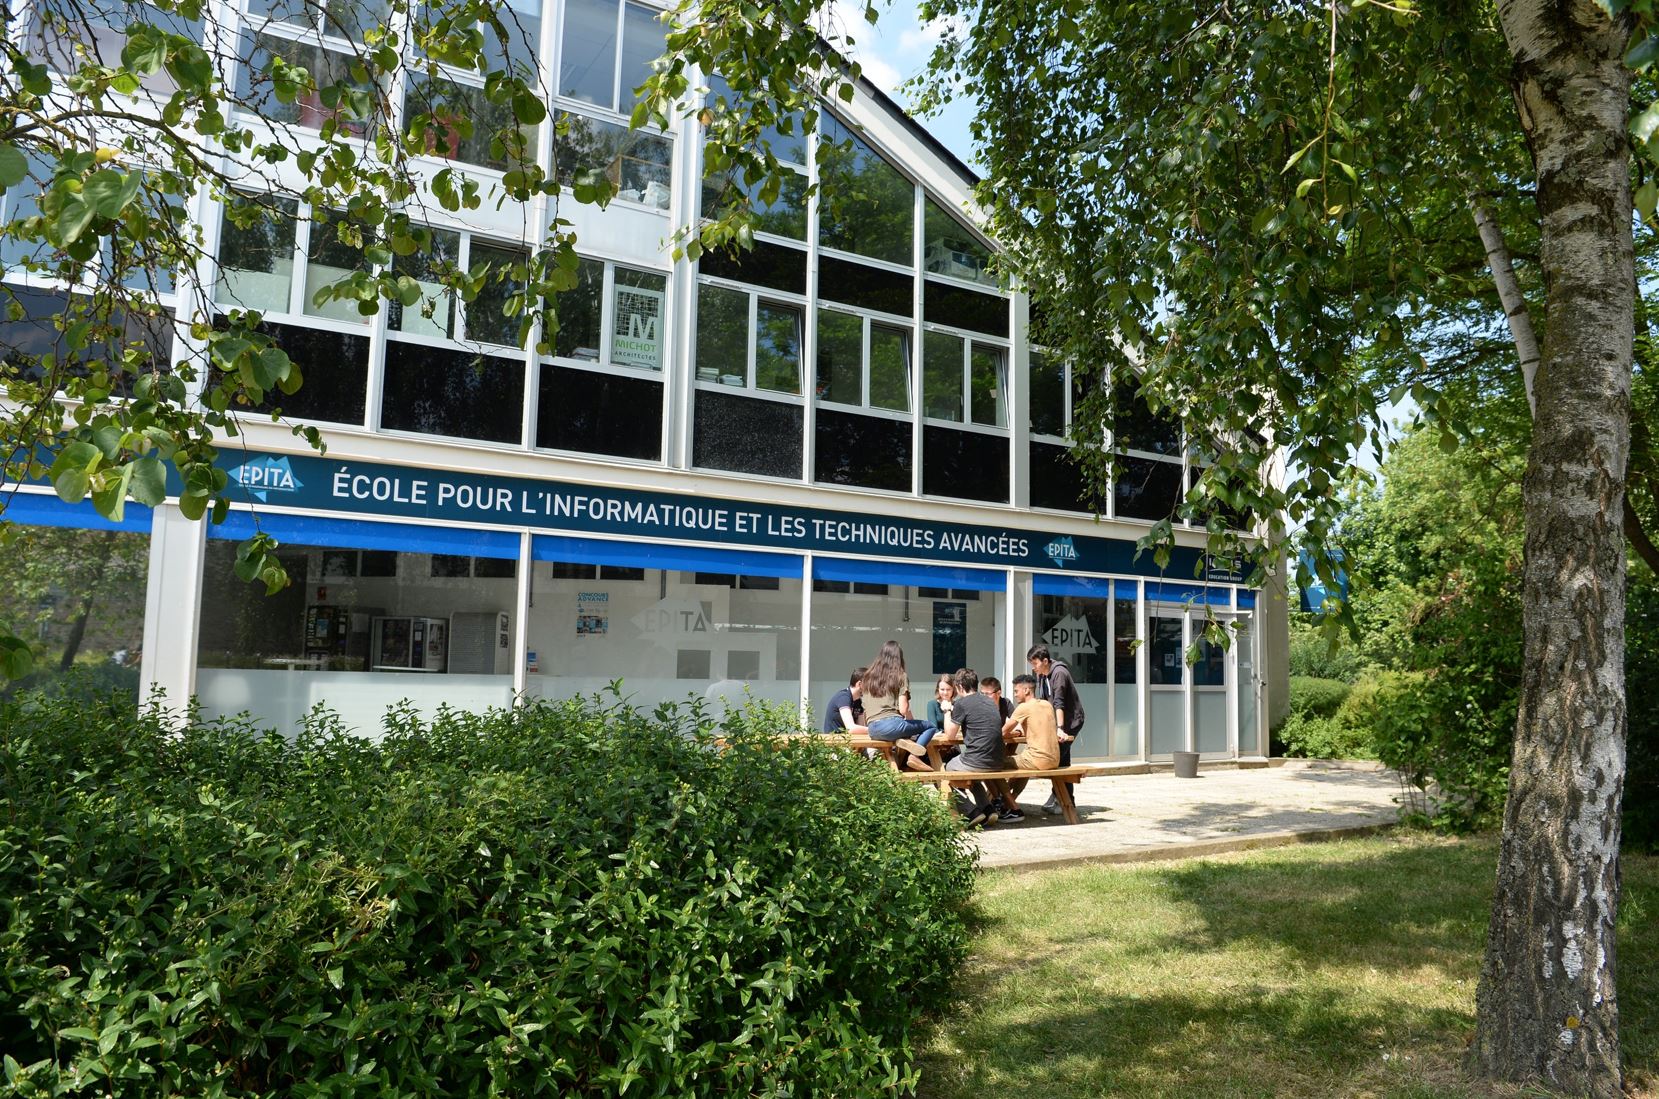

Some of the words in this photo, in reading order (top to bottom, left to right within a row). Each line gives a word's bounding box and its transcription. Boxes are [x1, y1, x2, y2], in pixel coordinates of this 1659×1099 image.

[615, 339, 657, 352] MICHOT
[614, 351, 657, 361] ARCHITECTES
[239, 465, 295, 488] EPITA
[332, 466, 429, 505] ÉCOLE
[437, 482, 513, 512] POUR
[521, 490, 729, 532] L'INFORMATIQUE
[735, 511, 762, 534] ET
[768, 515, 807, 538] LES
[812, 519, 935, 549] TECHNIQUES
[939, 532, 1029, 557] AVANCÉES
[1048, 542, 1076, 558] EPITA
[1208, 557, 1242, 569] IIS
[645, 609, 708, 632] EPITA
[1051, 627, 1093, 649] EPITA
